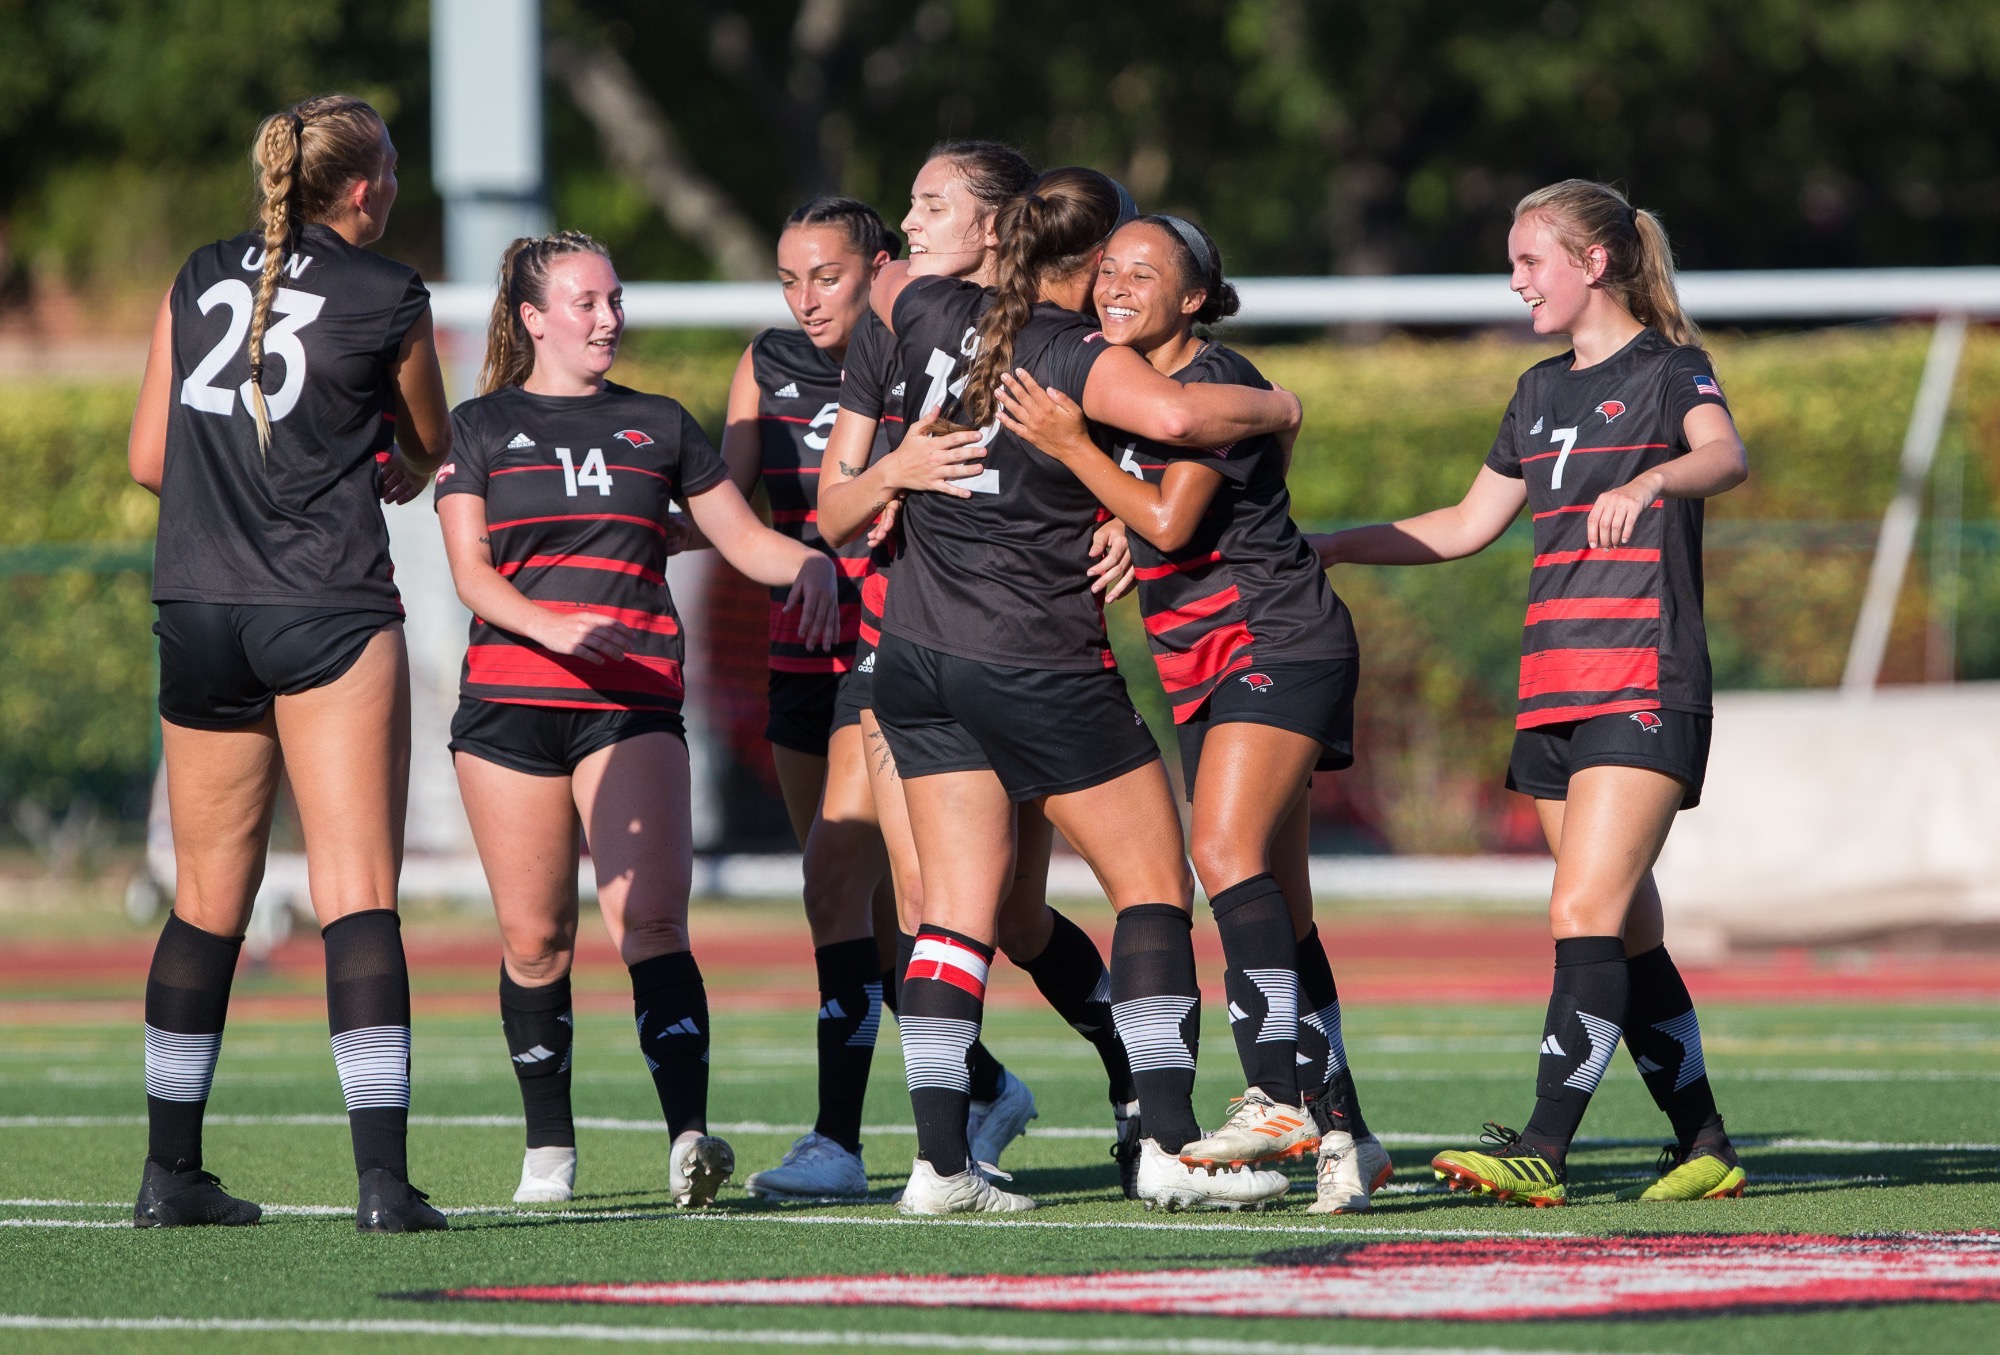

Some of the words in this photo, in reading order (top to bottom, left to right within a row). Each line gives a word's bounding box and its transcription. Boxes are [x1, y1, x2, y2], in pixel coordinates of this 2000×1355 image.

[241, 246, 314, 279] UW
[181, 279, 326, 421] 23
[803, 402, 840, 451] 5
[555, 447, 613, 497] 14
[1549, 425, 1578, 490] 7
